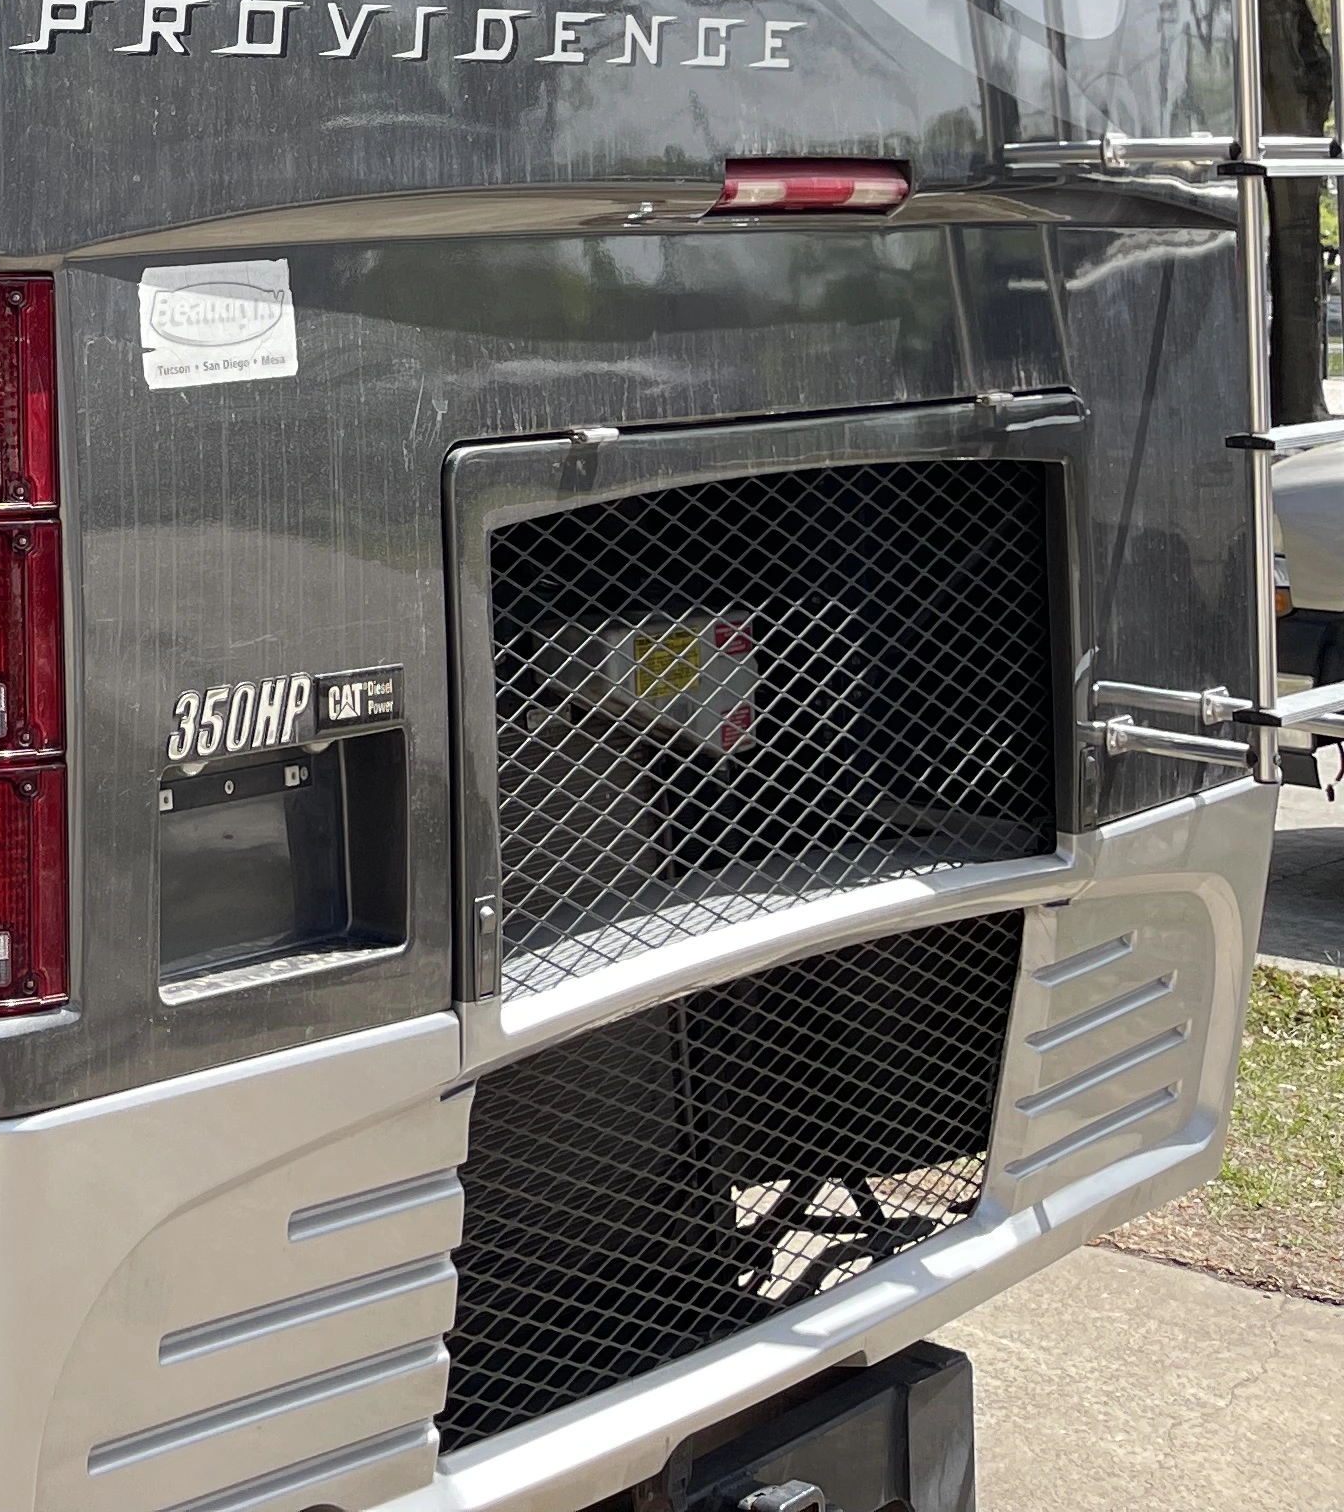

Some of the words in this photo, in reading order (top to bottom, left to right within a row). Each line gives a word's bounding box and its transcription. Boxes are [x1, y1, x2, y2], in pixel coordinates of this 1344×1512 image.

[157, 364, 191, 376] Tucson
[203, 360, 221, 372] San
[223, 358, 250, 372] Diego
[261, 354, 286, 366] Mesa
[328, 682, 363, 721] CAT
[367, 678, 393, 696] Diesel
[367, 700, 394, 716] Power
[167, 671, 312, 761] 350HP
